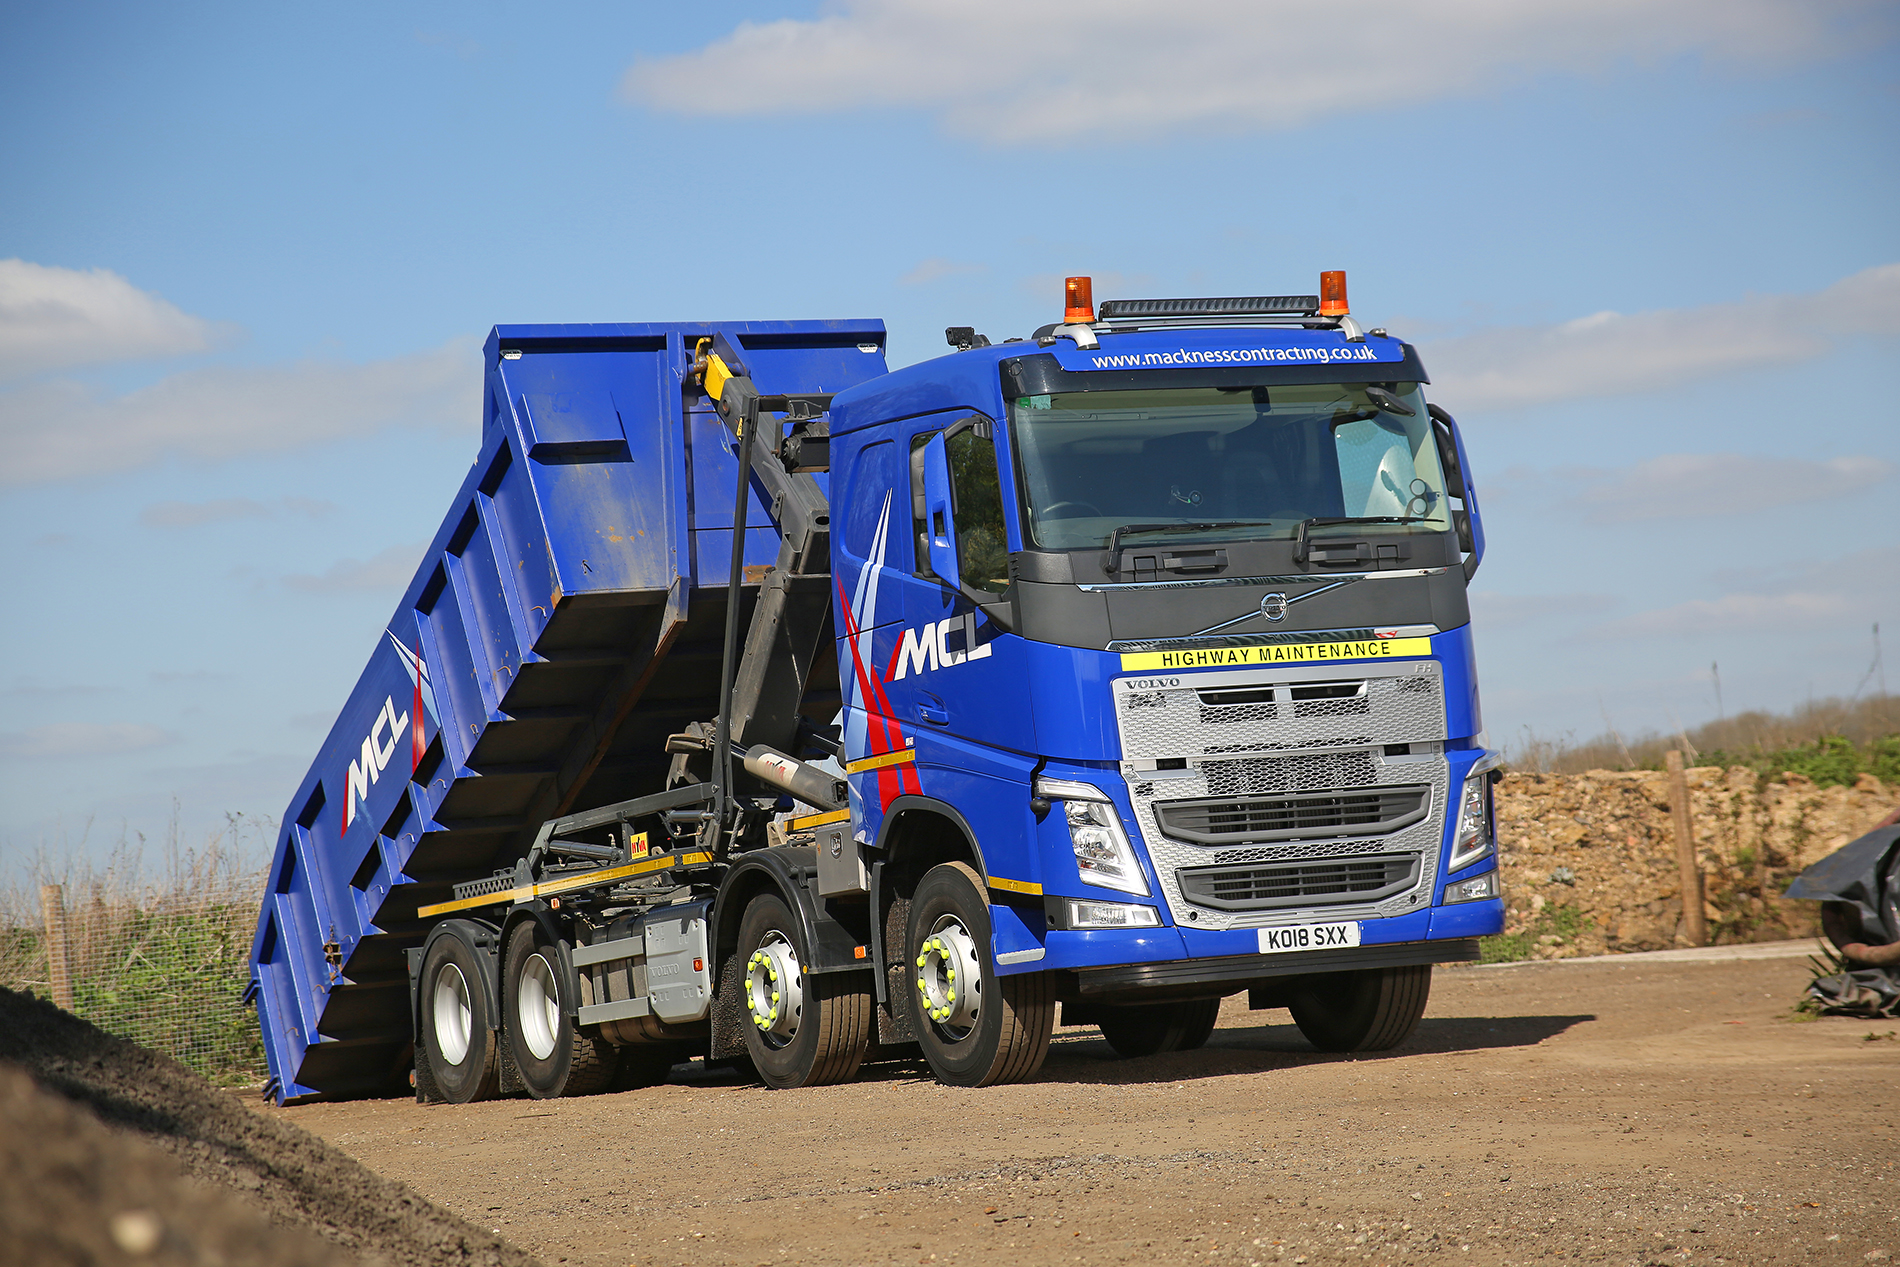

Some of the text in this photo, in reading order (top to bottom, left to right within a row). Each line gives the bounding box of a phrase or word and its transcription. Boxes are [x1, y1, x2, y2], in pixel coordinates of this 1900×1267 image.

[1092, 345, 1378, 368] www.macknesscontracting.co.uk
[893, 612, 992, 681] MCL
[1162, 641, 1391, 667] HIGHWAY MAINTENANCE
[1124, 677, 1180, 689] VOLVO
[347, 695, 409, 827] MCL
[1314, 925, 1348, 946] SXX
[649, 963, 680, 978] VOLVO
